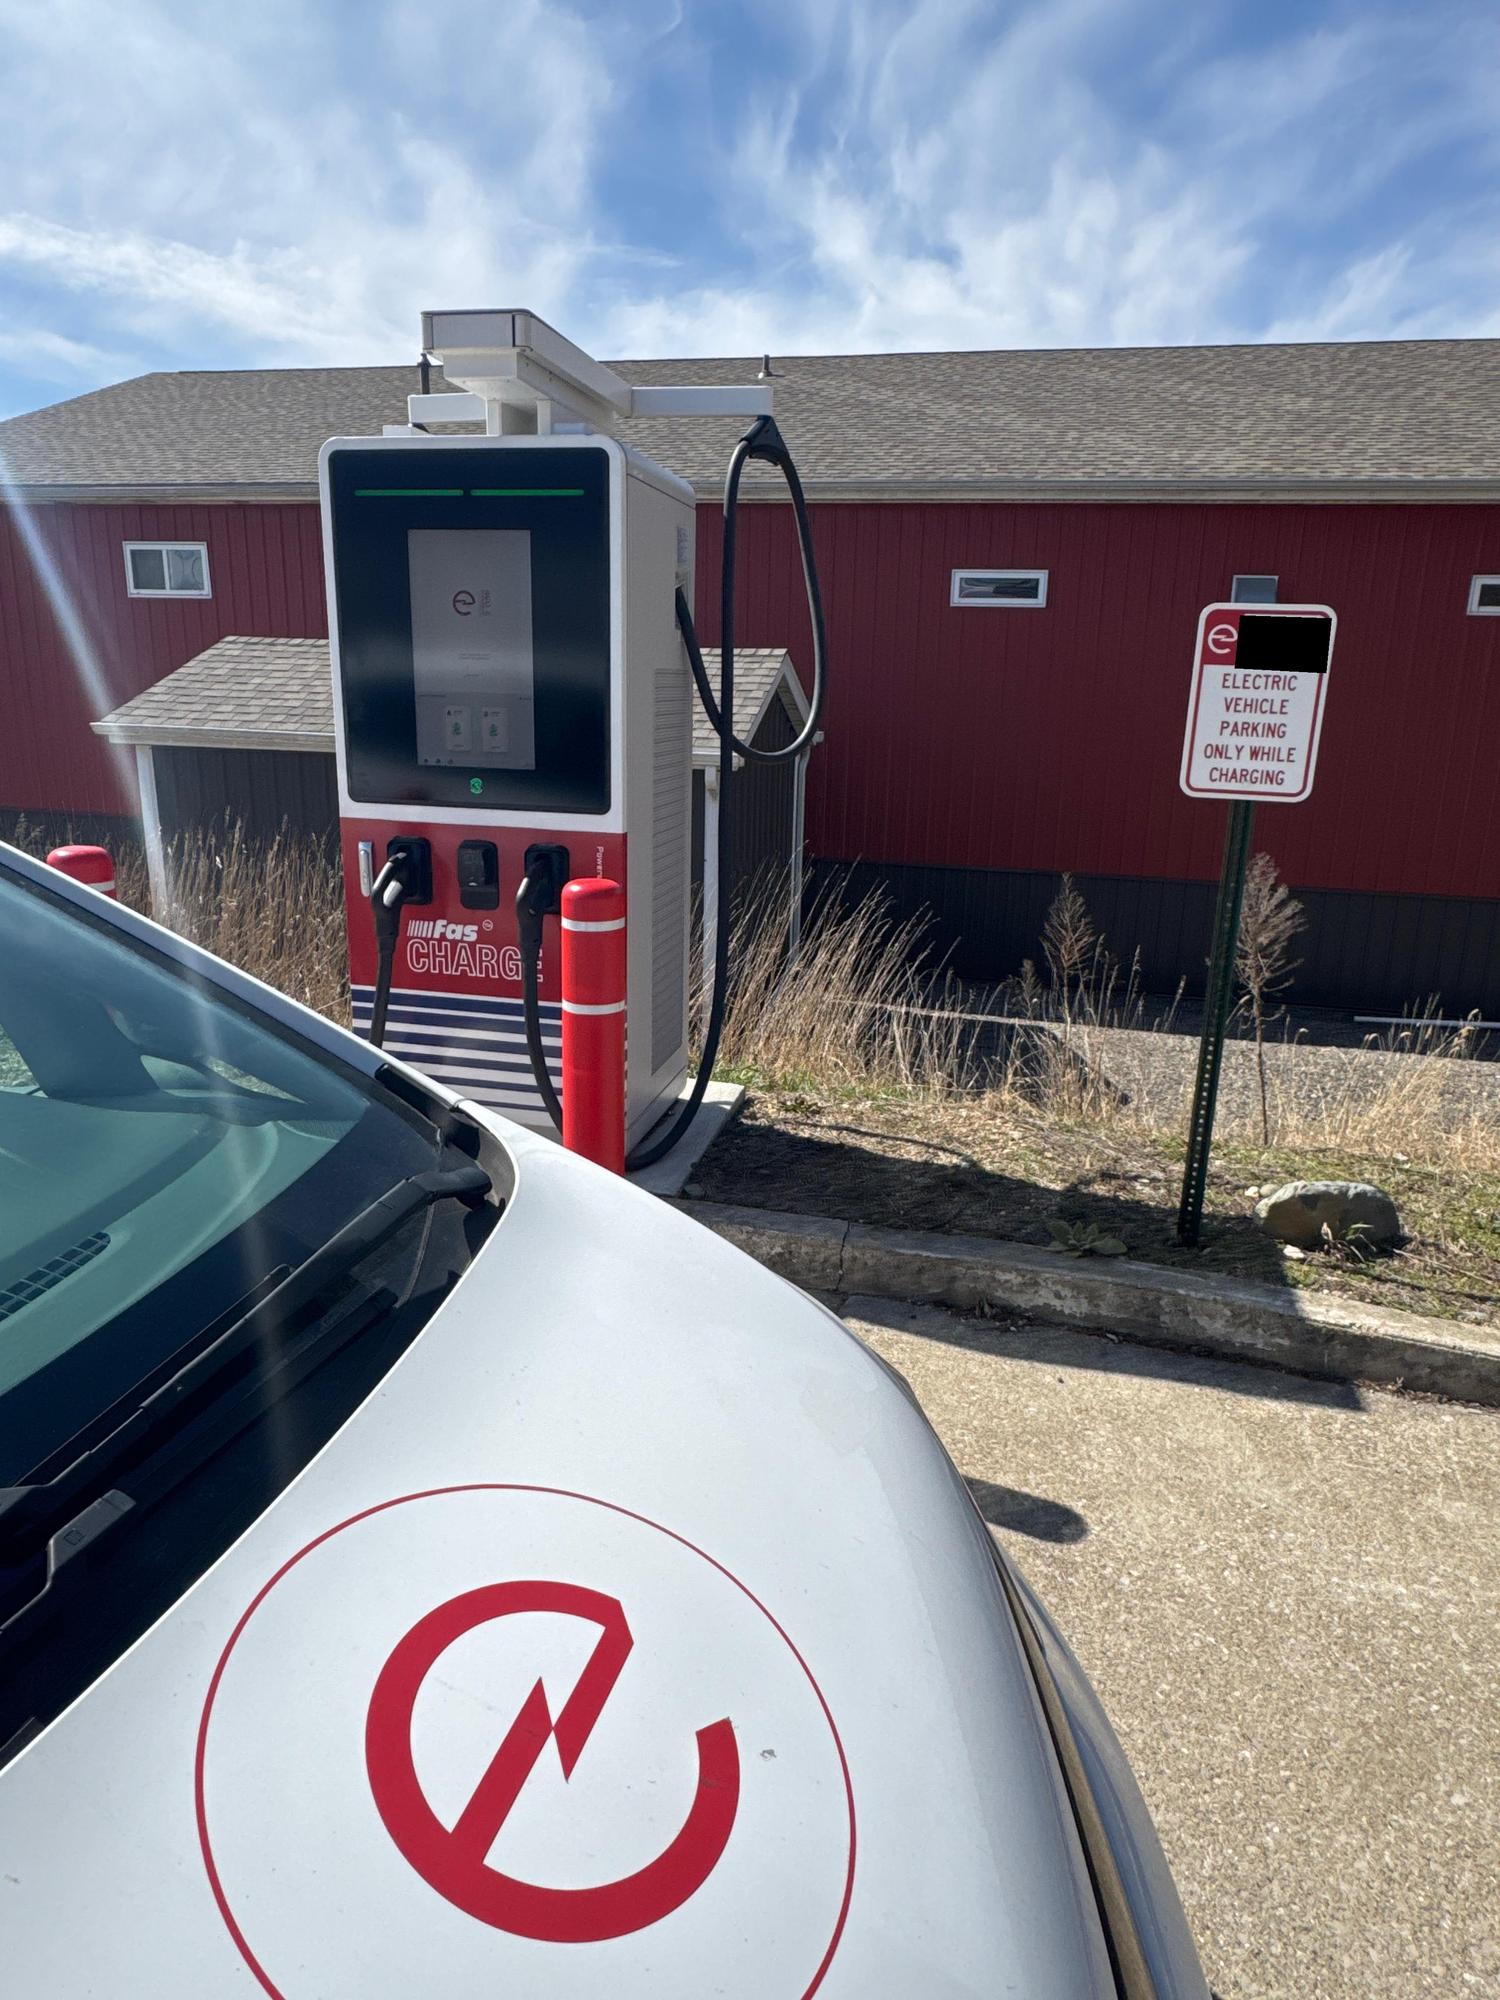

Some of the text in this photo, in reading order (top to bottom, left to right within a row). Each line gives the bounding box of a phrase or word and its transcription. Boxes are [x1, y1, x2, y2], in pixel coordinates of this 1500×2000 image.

[1222, 673, 1298, 691] ELECTRIC
[1224, 697, 1289, 715] VEHICLE
[1219, 721, 1287, 739] PARKING
[1203, 743, 1296, 763] ONLY WHILE
[1209, 767, 1285, 786] CHARGING
